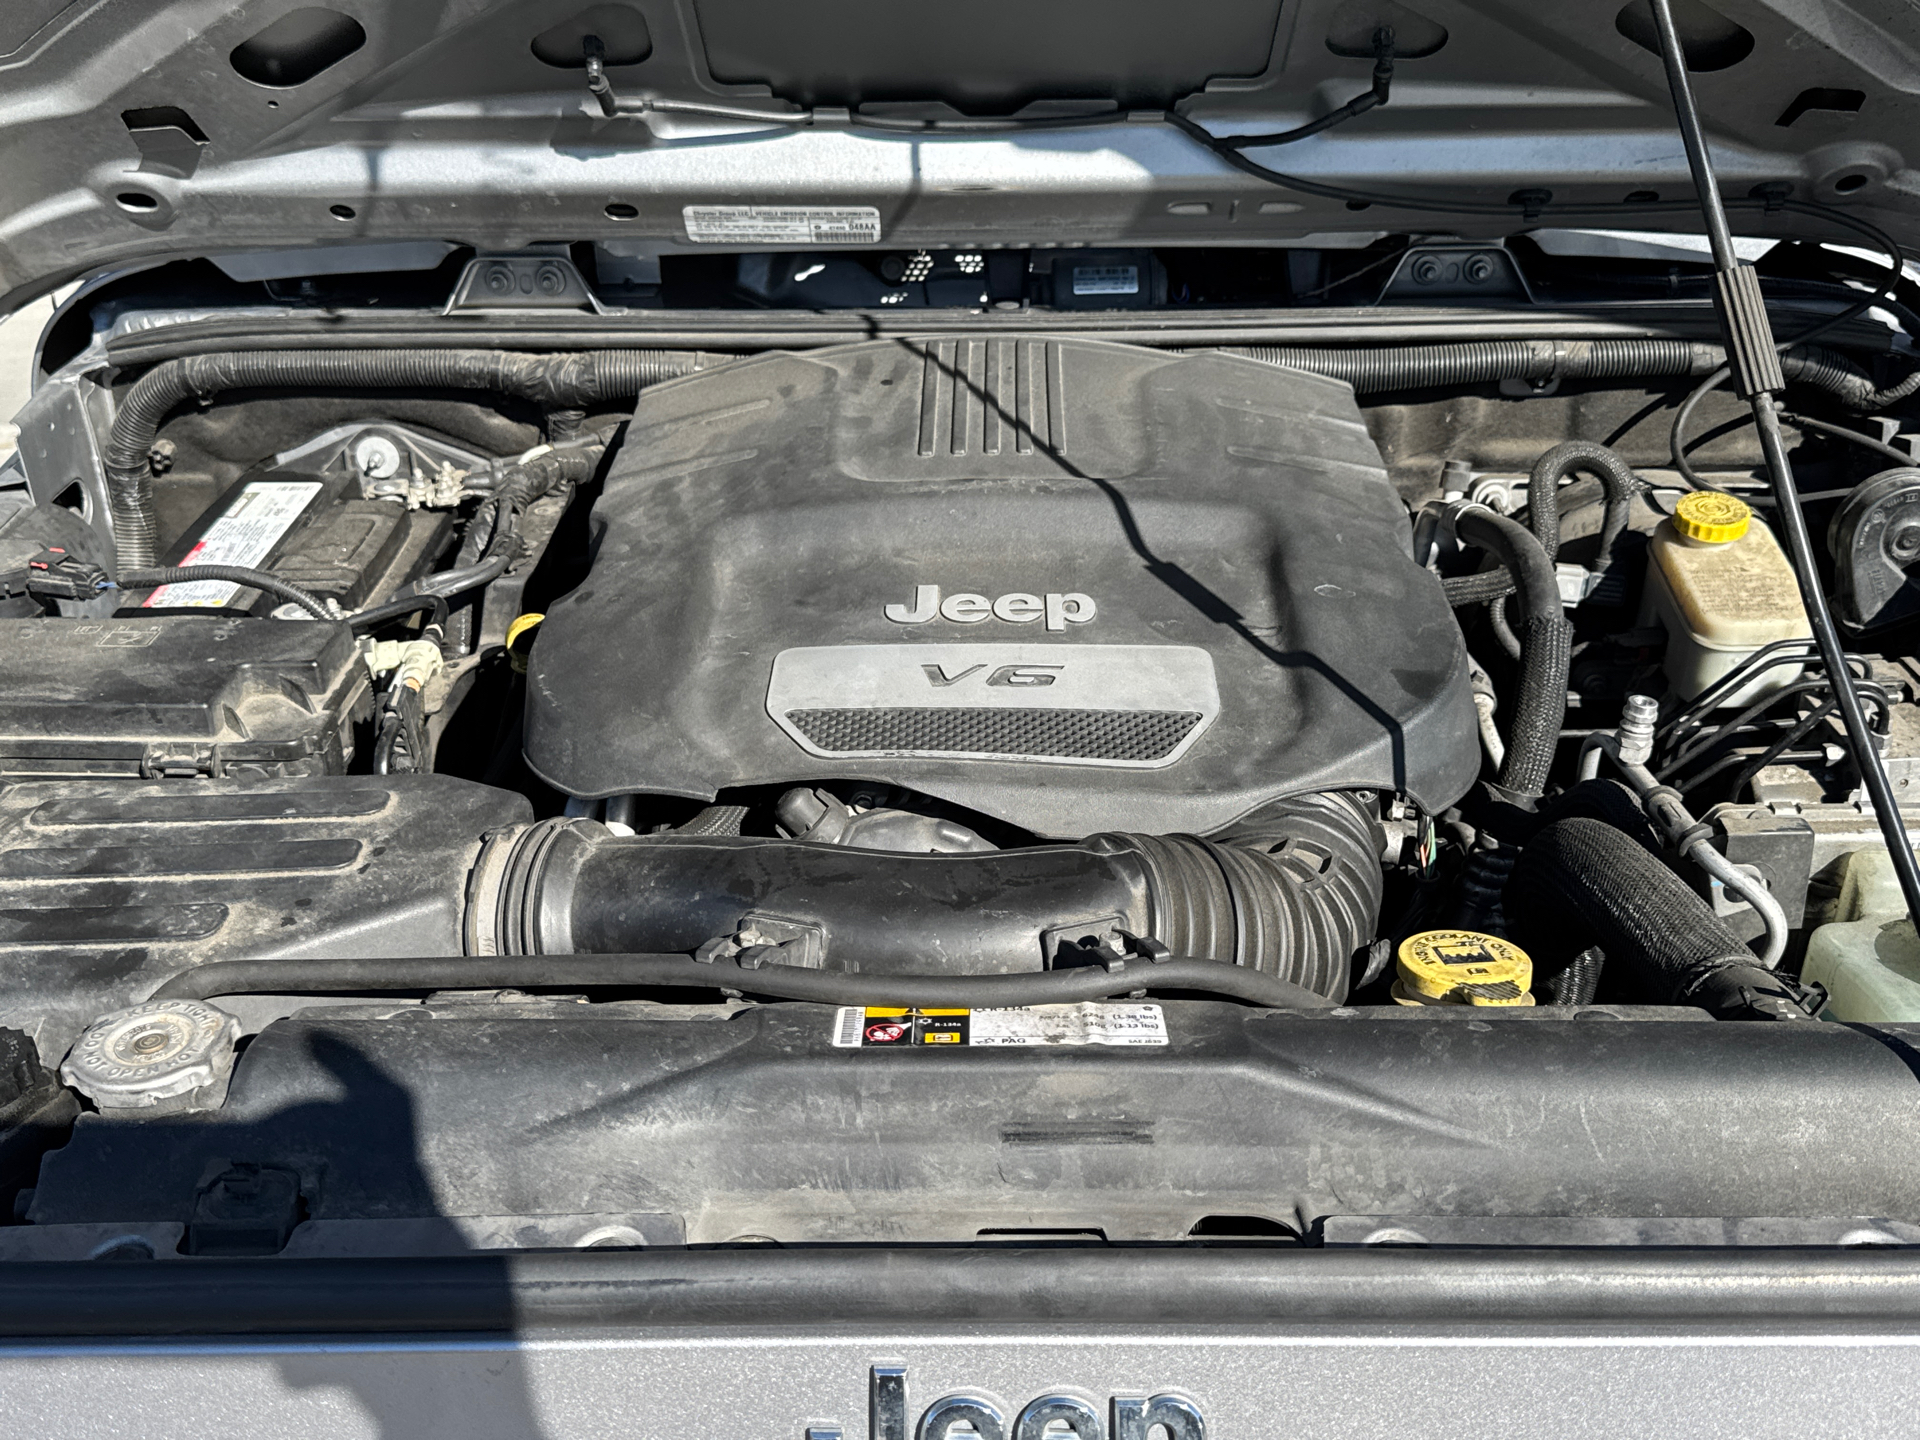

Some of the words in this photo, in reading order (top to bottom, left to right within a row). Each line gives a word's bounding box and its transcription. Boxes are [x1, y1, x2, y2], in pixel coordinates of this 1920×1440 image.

[884, 584, 1097, 632] Jeep
[921, 663, 1065, 688] V6
[126, 1001, 181, 1018] KEEP
[183, 1003, 217, 1029] TIGHT
[83, 1050, 108, 1071] NOT
[107, 1063, 159, 1078] OPEN
[167, 1048, 200, 1068] HOT
